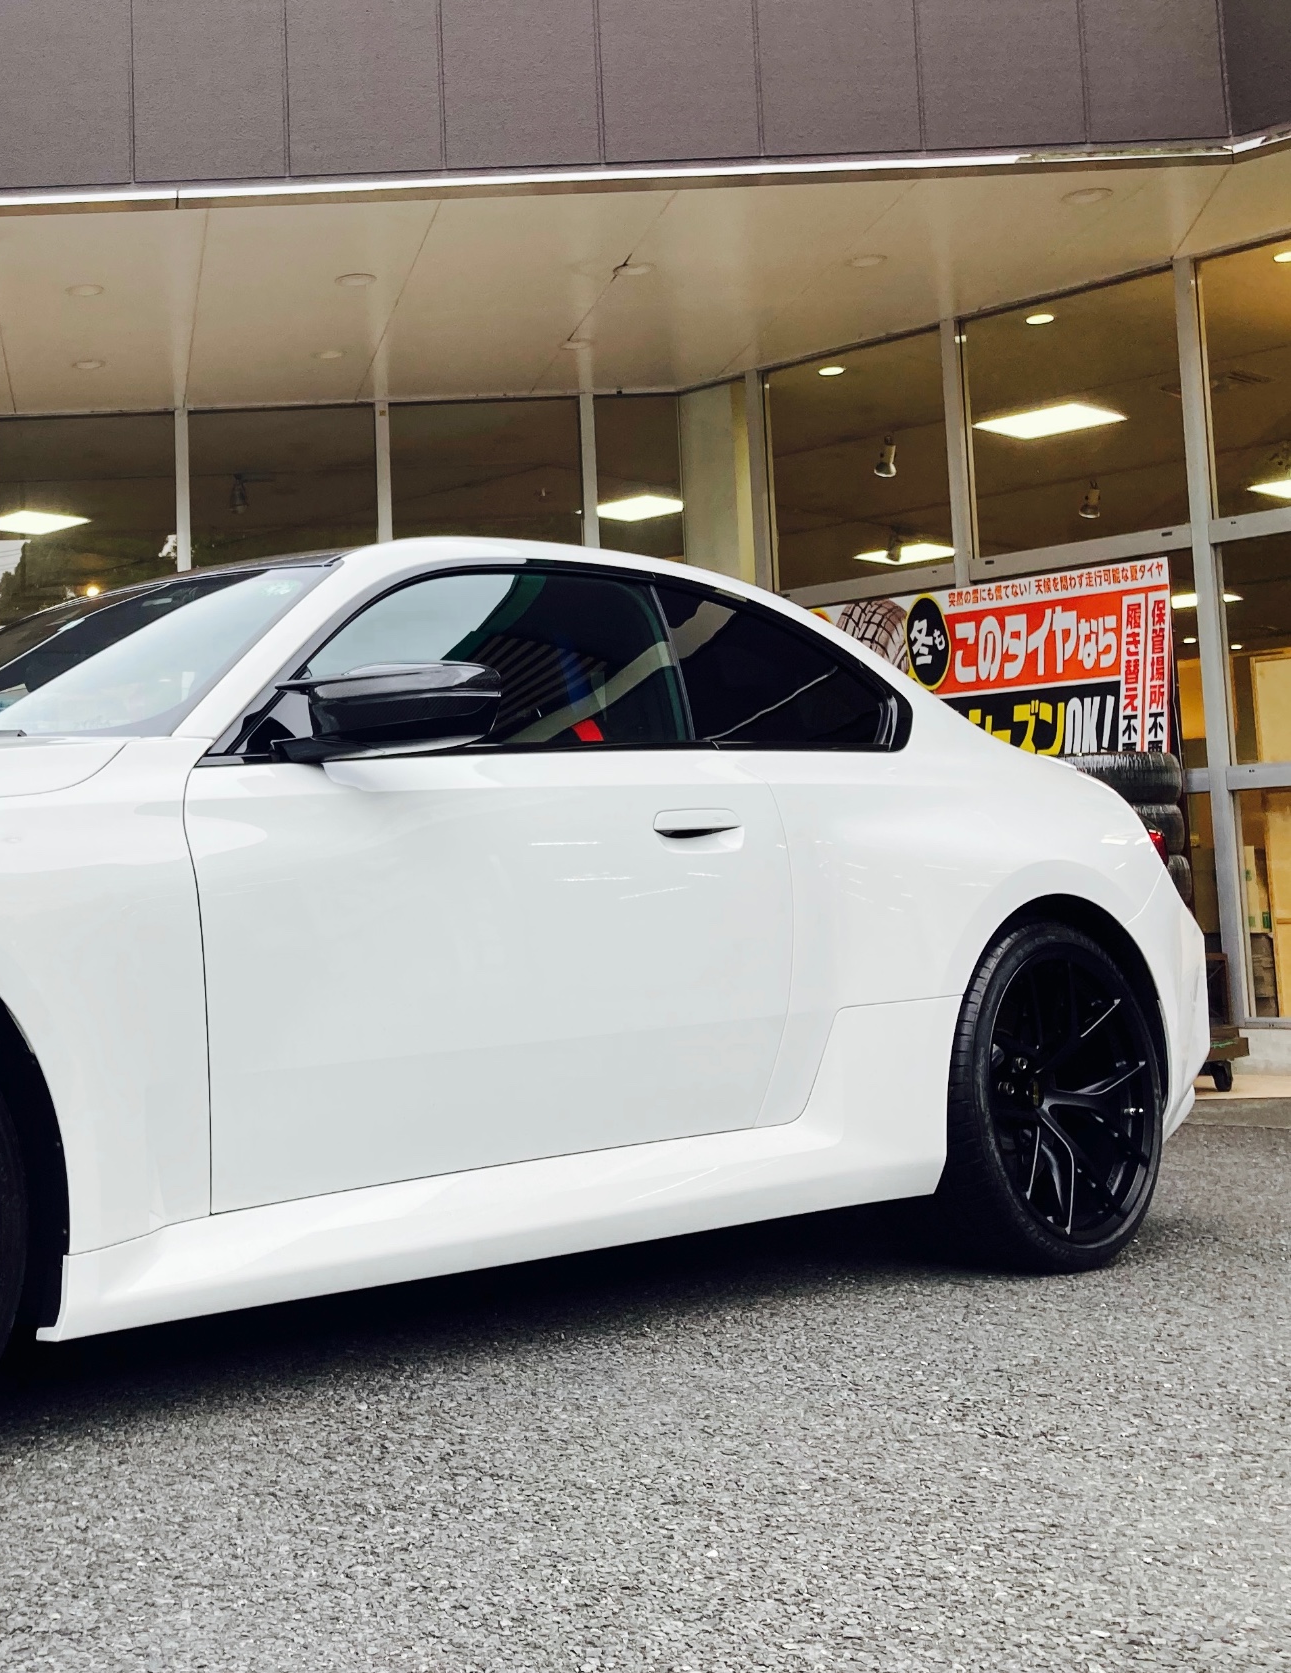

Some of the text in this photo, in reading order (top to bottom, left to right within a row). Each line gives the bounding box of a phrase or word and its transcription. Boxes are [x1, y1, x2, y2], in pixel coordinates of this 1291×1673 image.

[909, 618, 946, 667] 冬も
[953, 605, 1118, 684] このタイヤなら
